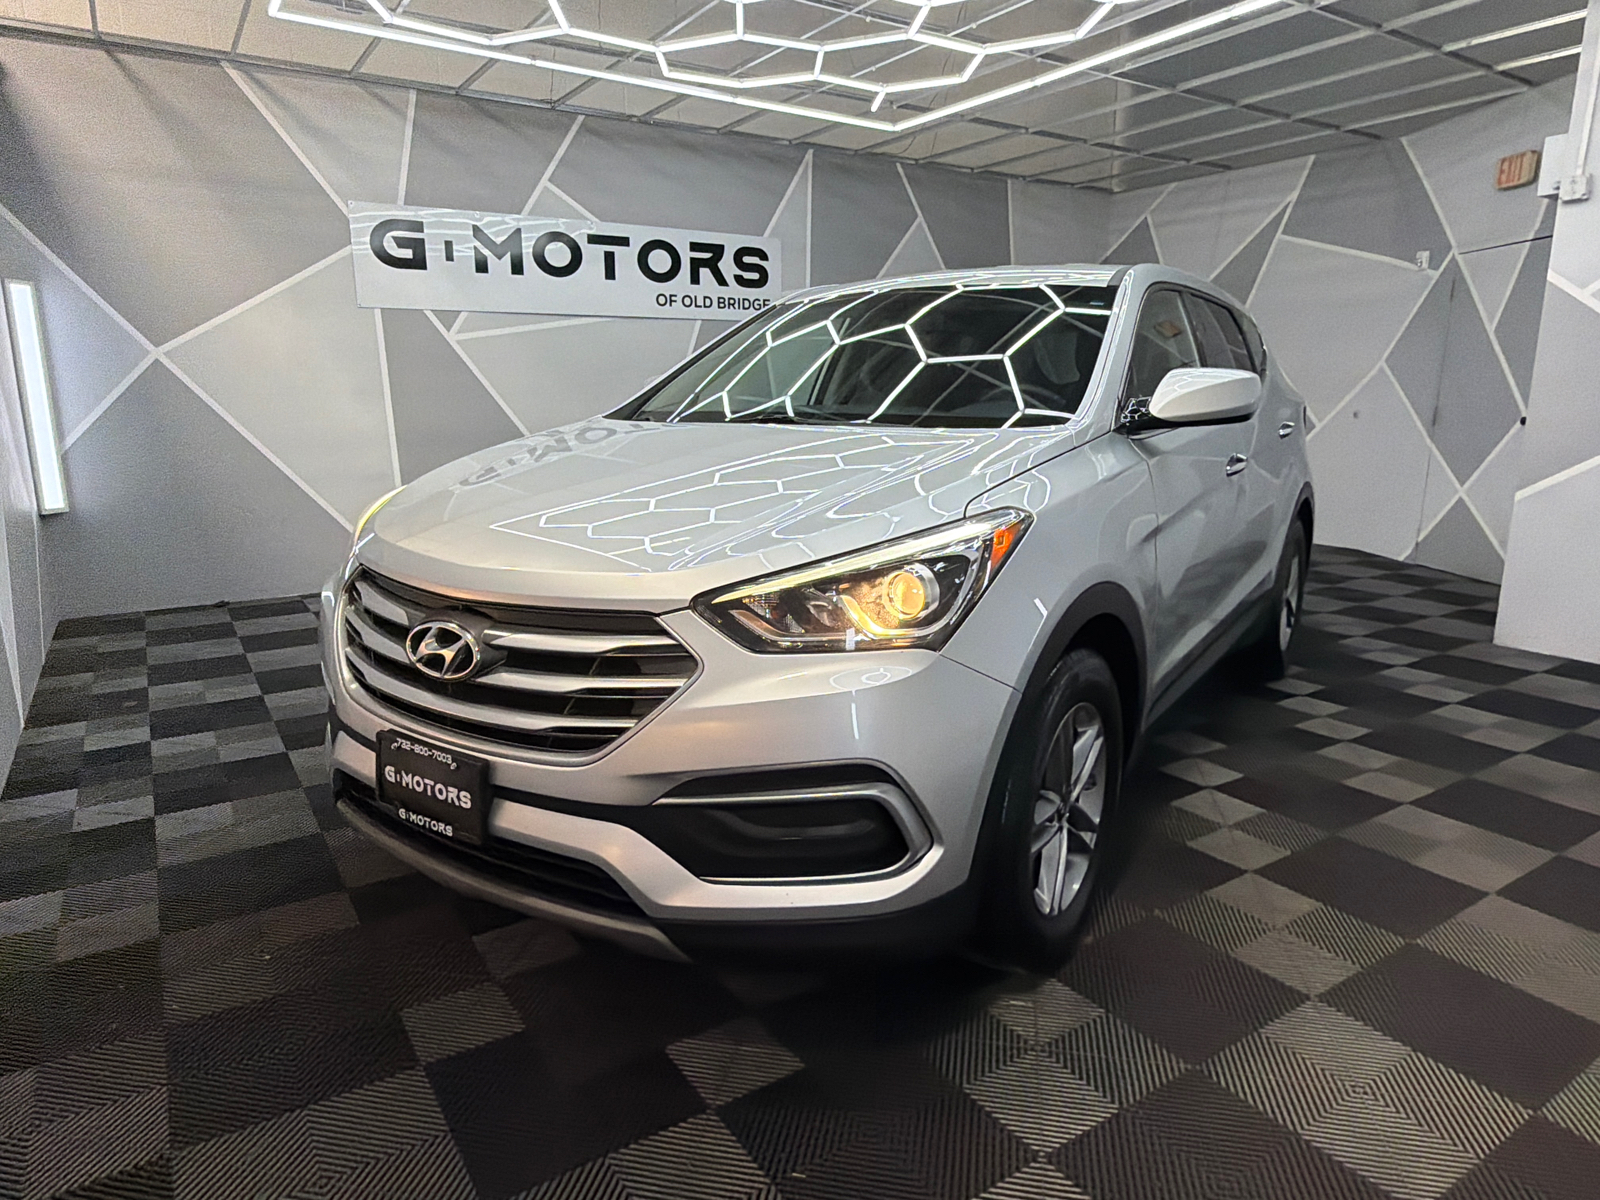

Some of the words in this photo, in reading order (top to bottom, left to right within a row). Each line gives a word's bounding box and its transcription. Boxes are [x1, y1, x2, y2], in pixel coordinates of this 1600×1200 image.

[655, 293, 677, 307] OF
[681, 294, 713, 309] OLD
[717, 296, 771, 311] BRIDGE
[396, 737, 453, 764] 732-800-7003
